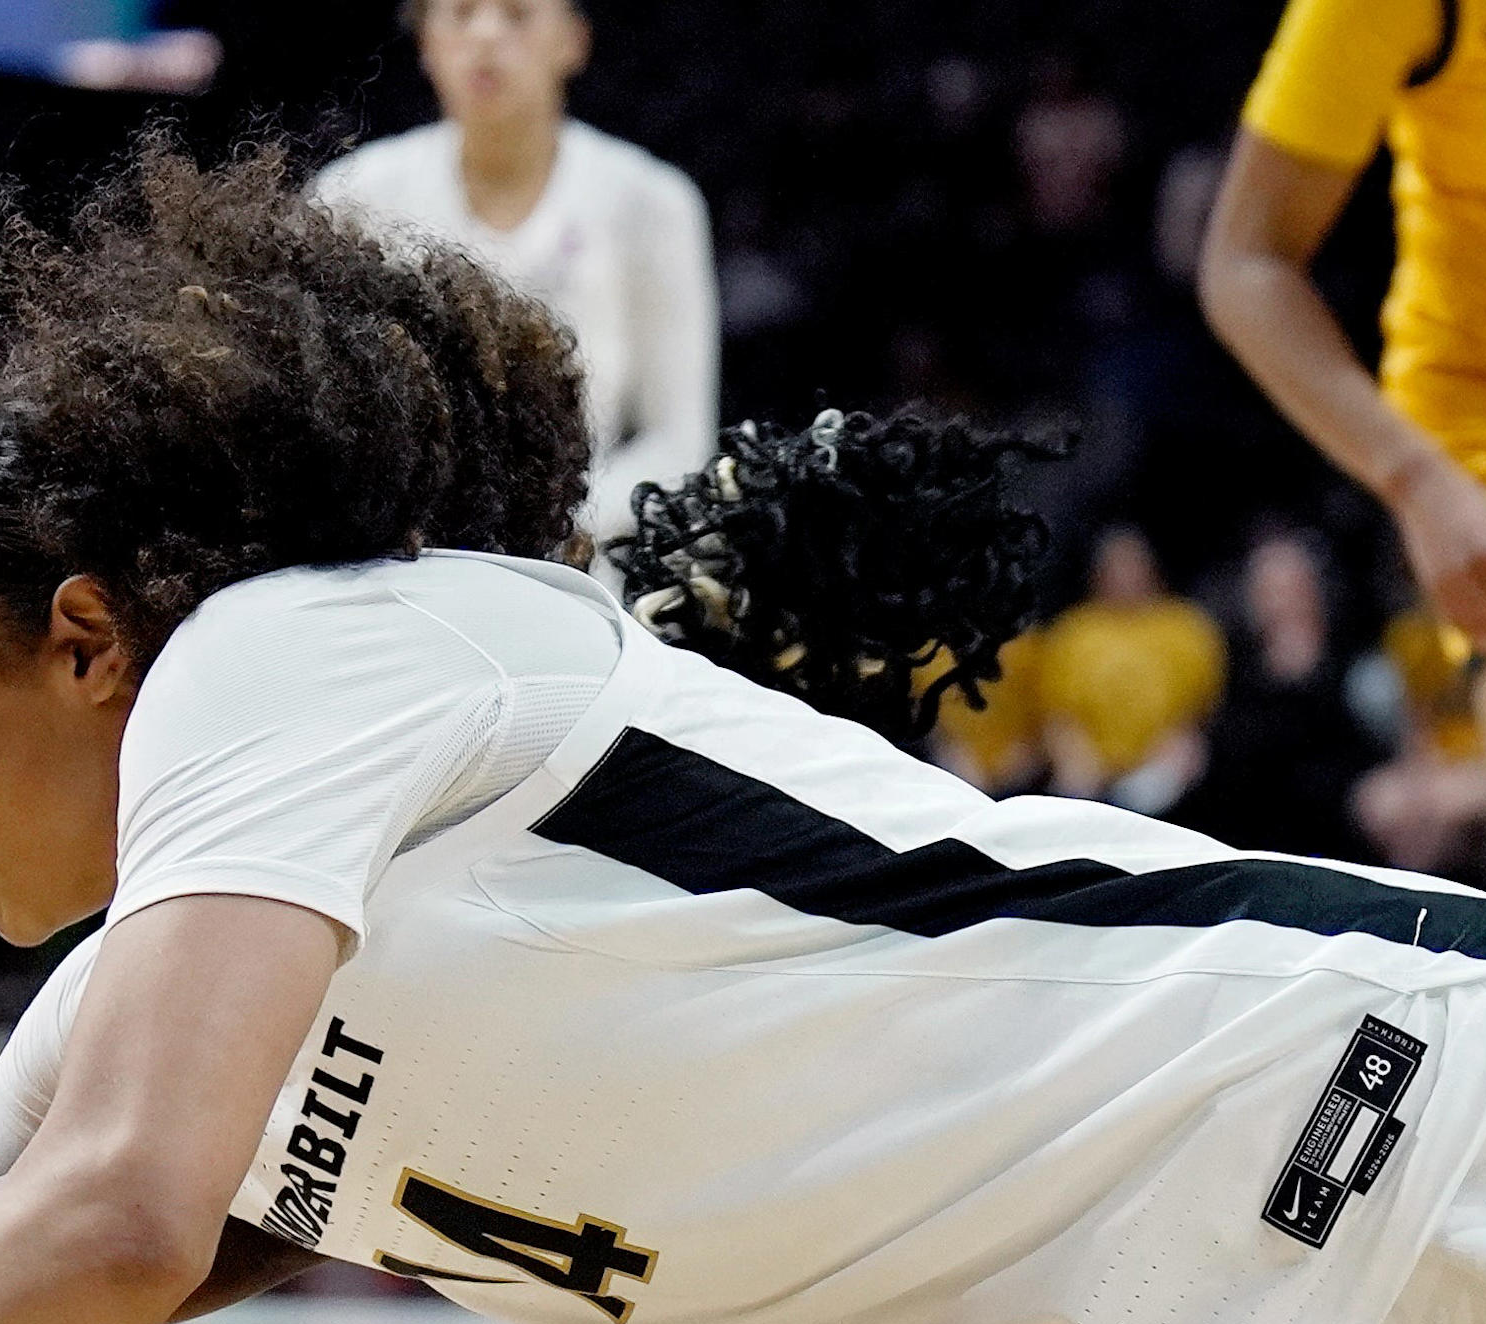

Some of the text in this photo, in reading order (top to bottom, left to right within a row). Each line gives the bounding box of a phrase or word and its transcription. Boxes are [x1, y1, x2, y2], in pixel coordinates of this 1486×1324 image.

[1358, 1054, 1392, 1091] 48
[1299, 1093, 1342, 1163] ENGINEERED
[1301, 1186, 1331, 1229] TEAM
